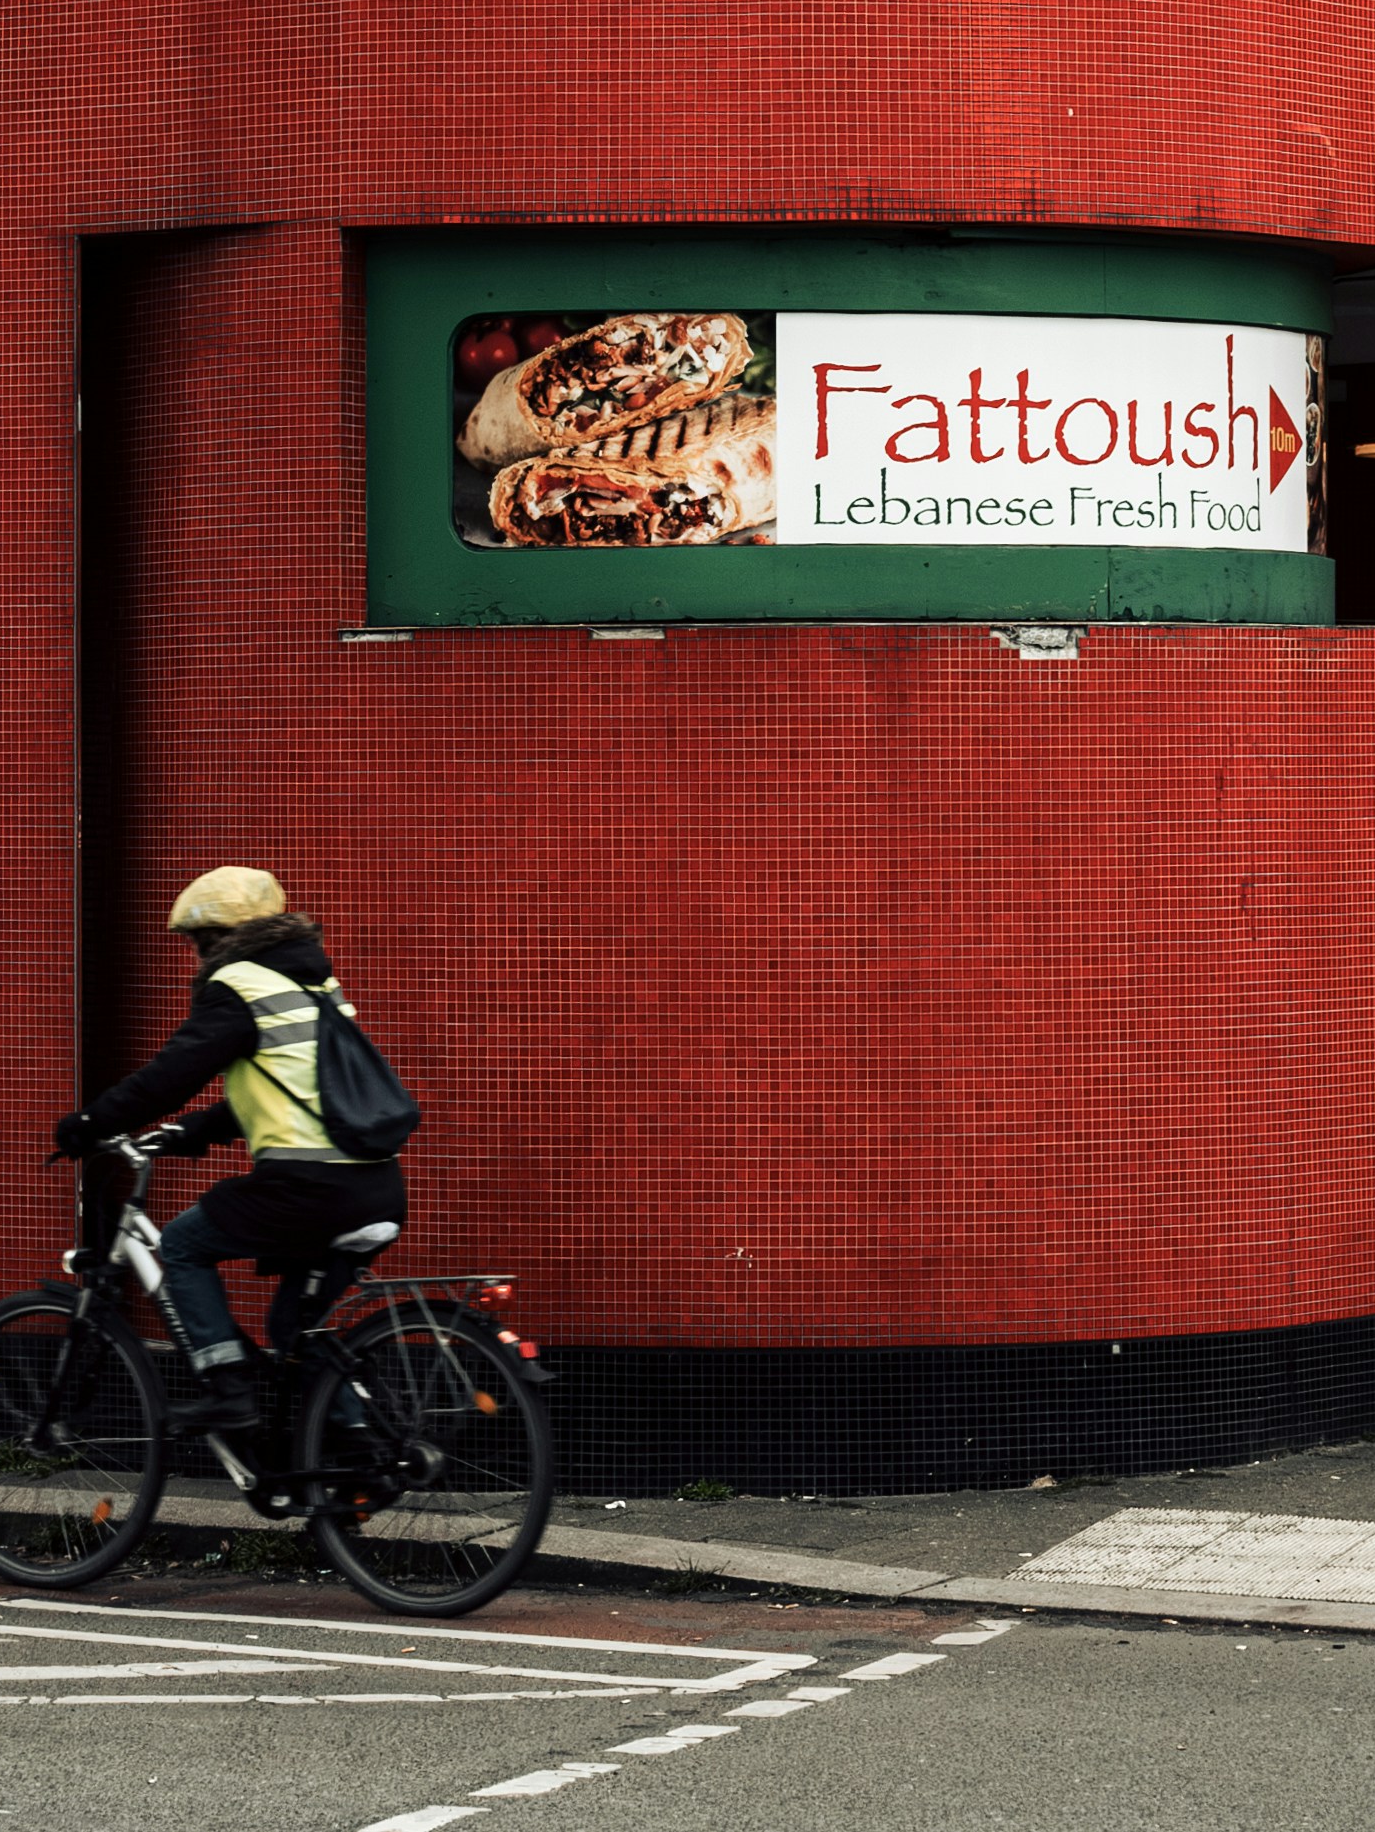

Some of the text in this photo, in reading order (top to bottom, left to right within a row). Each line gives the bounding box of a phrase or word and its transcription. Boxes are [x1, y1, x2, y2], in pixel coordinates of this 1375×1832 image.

[811, 332, 1260, 471] Fattoush
[1270, 425, 1296, 453] 10m
[813, 467, 1261, 532] Lebanese Fresh Food
